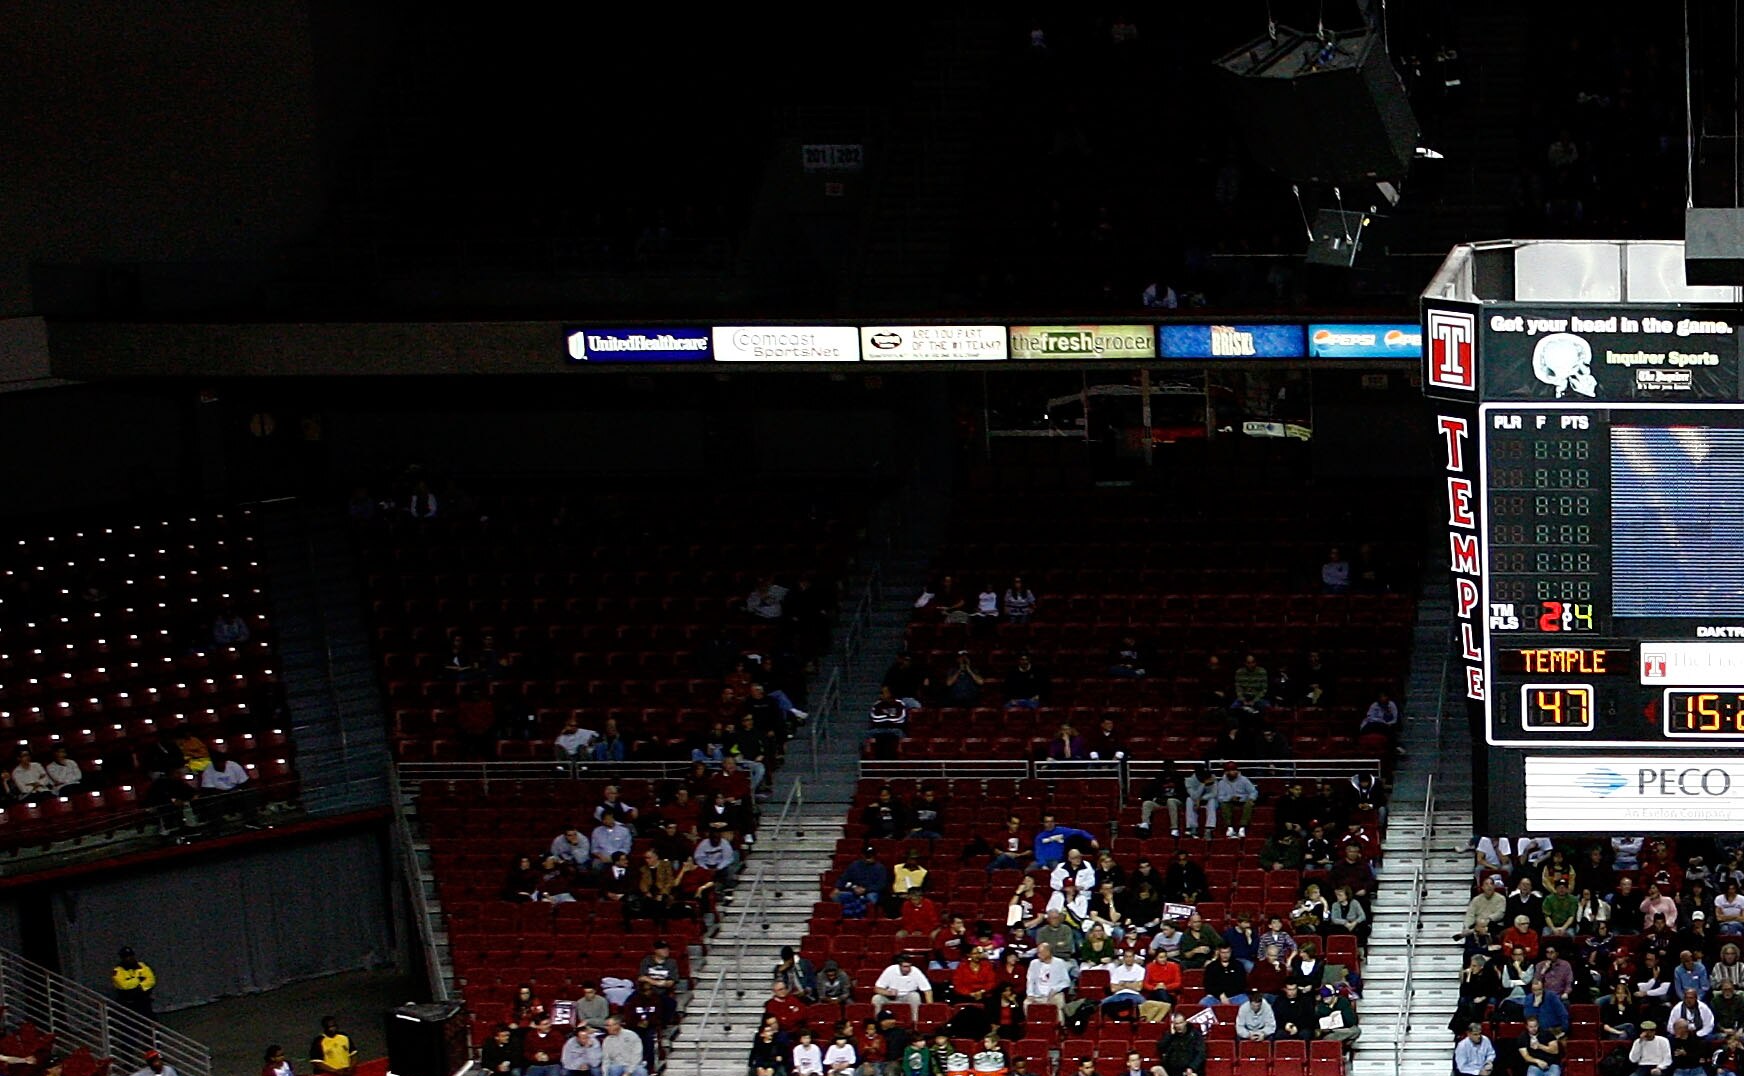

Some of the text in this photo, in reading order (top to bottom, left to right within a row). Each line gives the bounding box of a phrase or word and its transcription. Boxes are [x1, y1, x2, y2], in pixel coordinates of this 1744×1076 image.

[1490, 315, 1734, 337] Get your head in the game.
[1329, 333, 1377, 346] PEPSI
[753, 346, 840, 359] SportsNet
[1605, 350, 1720, 368] Inquirer Sports
[1493, 415, 1590, 430] PLR F PTS
[1437, 415, 1484, 700] TEMPLE
[1491, 603, 1515, 617] TM
[1539, 601, 1562, 632] 2
[1574, 603, 1593, 630] 4
[1490, 616, 1520, 630] FLS
[1520, 649, 1606, 674] TEMPLE
[1537, 689, 1588, 724] 47
[1638, 767, 1731, 796] PECO
